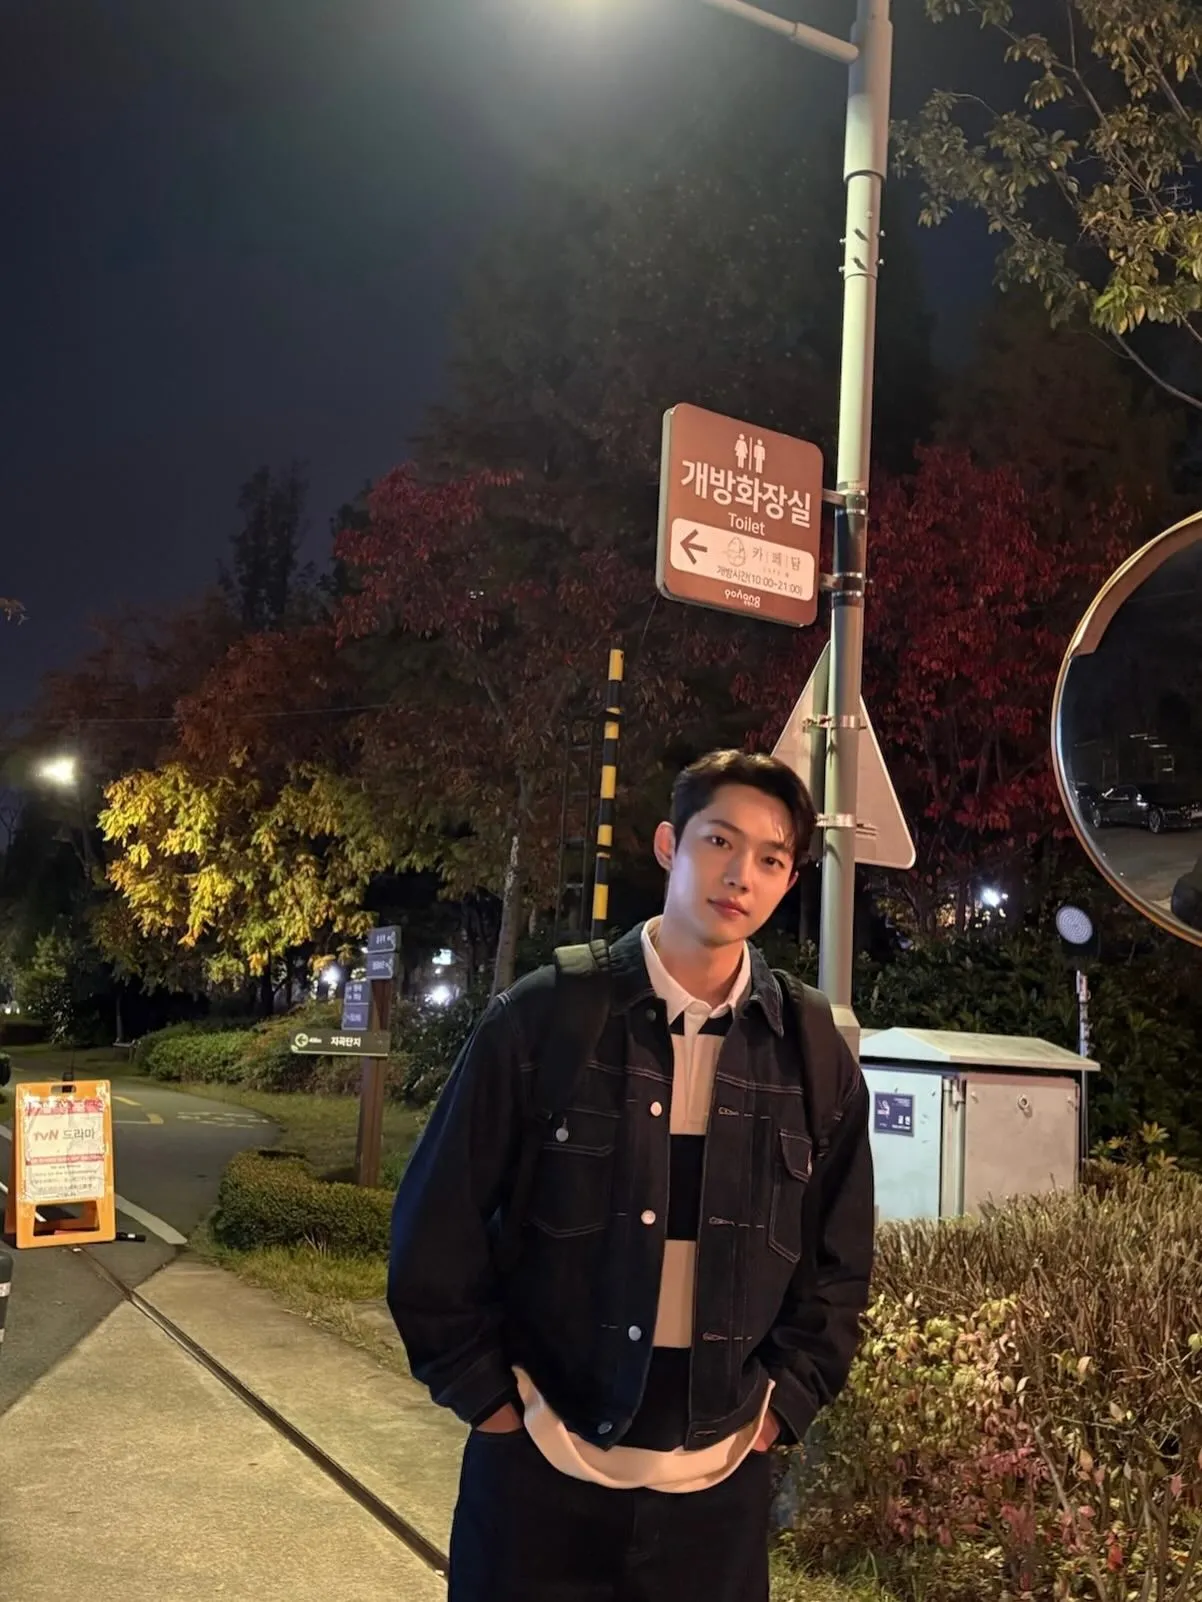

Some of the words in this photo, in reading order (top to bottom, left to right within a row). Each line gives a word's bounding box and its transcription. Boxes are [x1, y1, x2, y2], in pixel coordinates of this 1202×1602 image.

[680, 460, 811, 528] 개방화장실
[728, 512, 765, 536] Toilet
[33, 1129, 59, 1141] tvN
[62, 1128, 95, 1141] 드라마
